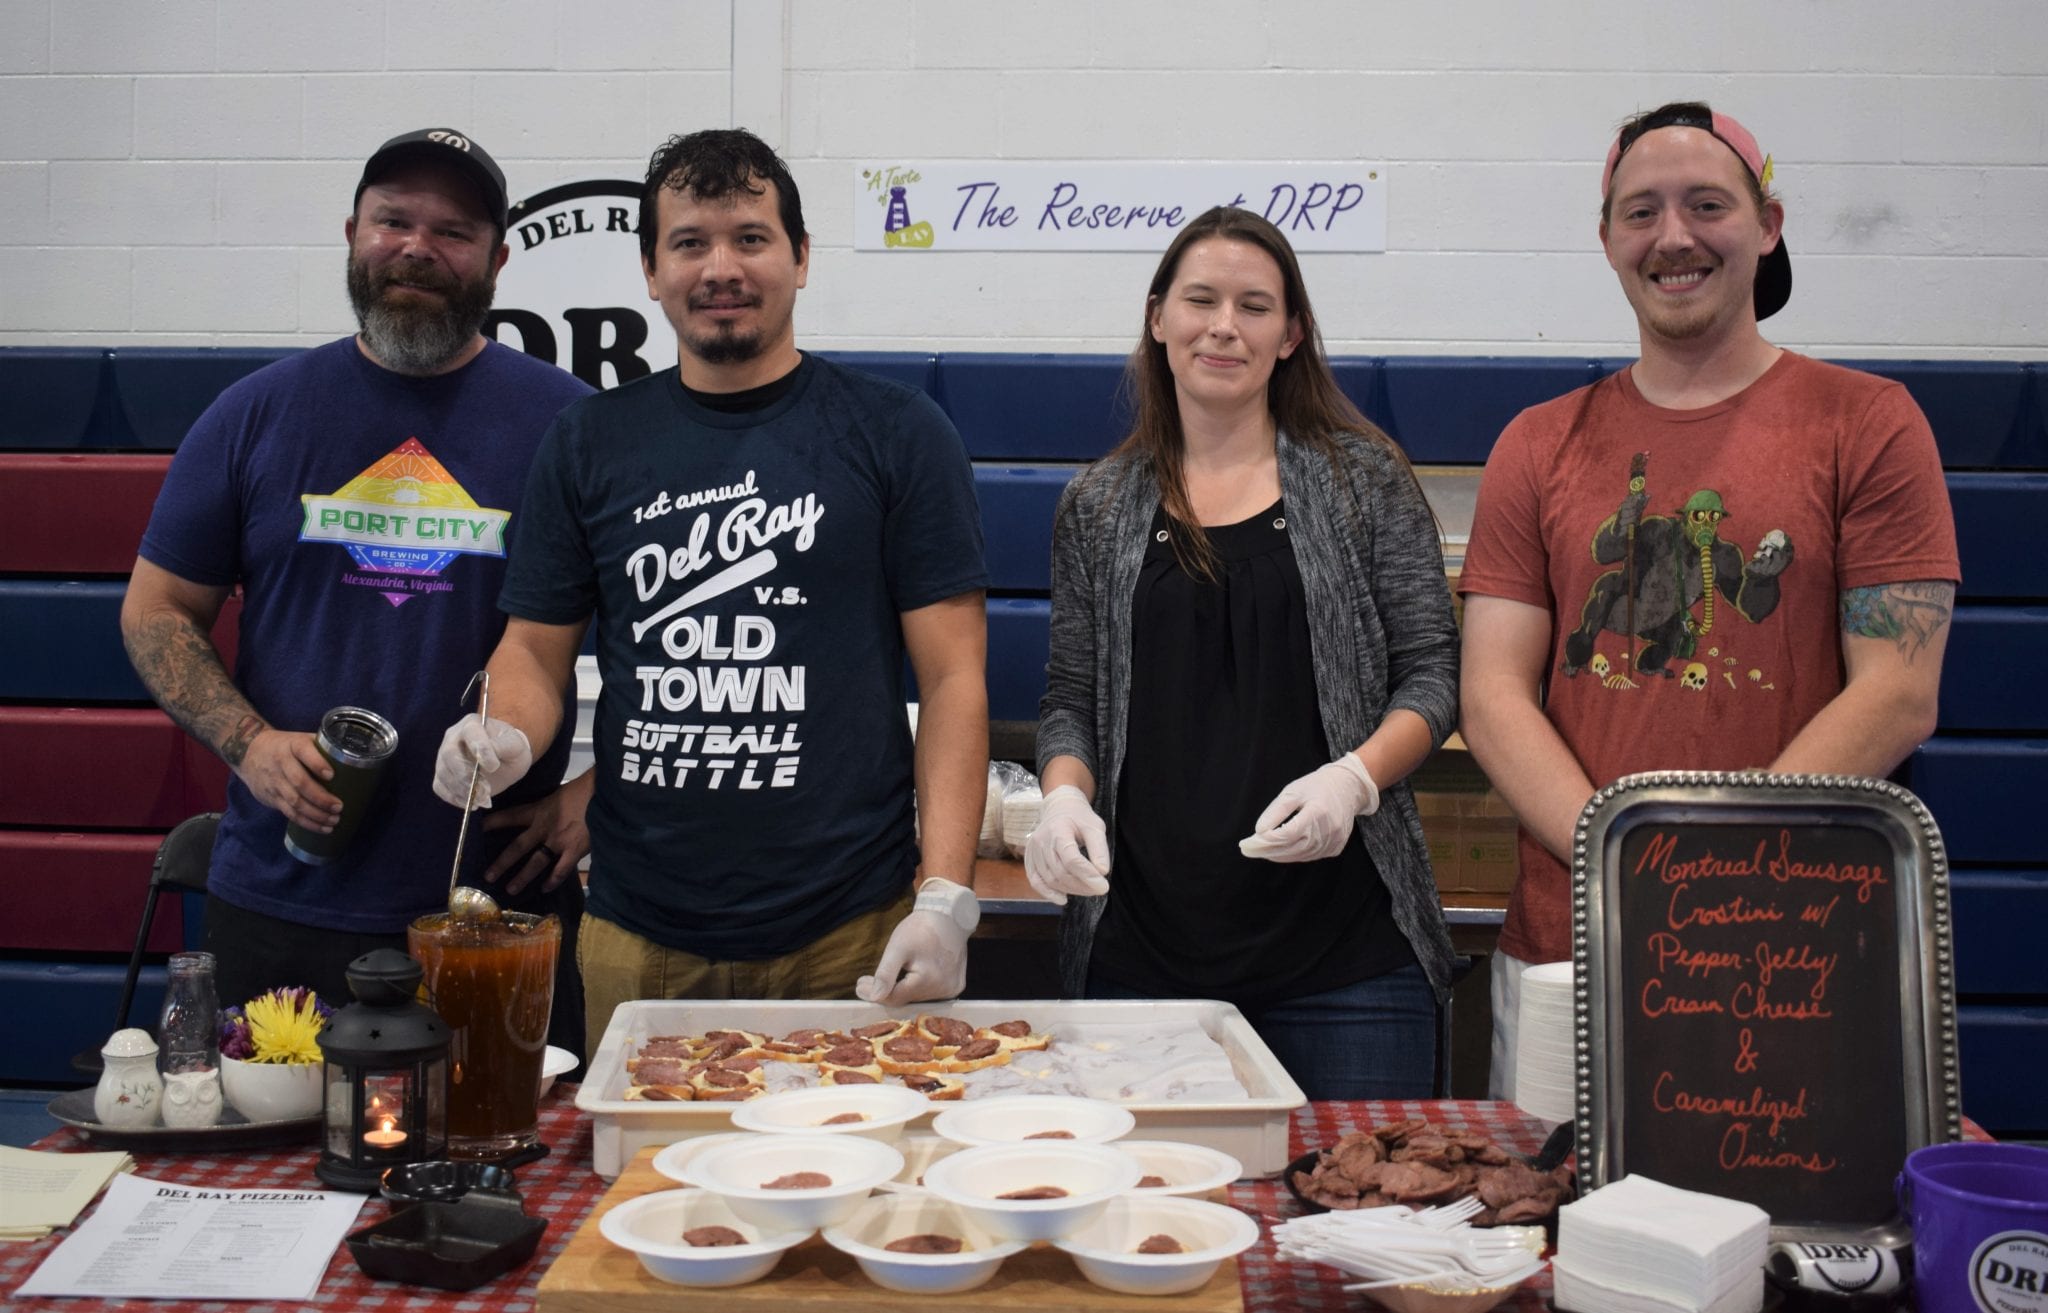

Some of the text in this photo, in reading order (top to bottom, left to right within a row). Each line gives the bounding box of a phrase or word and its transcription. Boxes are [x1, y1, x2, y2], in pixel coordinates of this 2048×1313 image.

[885, 165, 922, 190] Taste
[952, 182, 1019, 232] The
[1037, 182, 1186, 231] Reserve
[1265, 182, 1363, 231] DRP
[517, 208, 594, 251] DEL
[633, 470, 759, 524] 1st annual
[320, 508, 490, 541] PORT CITY
[371, 549, 429, 561] BREWING
[626, 493, 825, 602] Del Ray
[341, 573, 454, 593] Alexandria, Virginia
[661, 615, 776, 660] OLD
[636, 666, 806, 712] TOWN
[622, 719, 803, 754] SOFTBALL
[620, 752, 800, 789] BATTLE
[1635, 829, 1888, 903] Montreal Sausage
[1668, 883, 1783, 930] Crostini
[1641, 978, 1724, 1018] Cream
[1734, 1028, 1759, 1073] &
[1653, 1071, 1807, 1137] Caramelized
[1719, 1122, 1836, 1171] Onions
[156, 1187, 192, 1199] DEL
[196, 1191, 236, 1200] RAY
[1807, 1244, 1869, 1259] DRP
[2008, 1244, 2029, 1253] DEL
